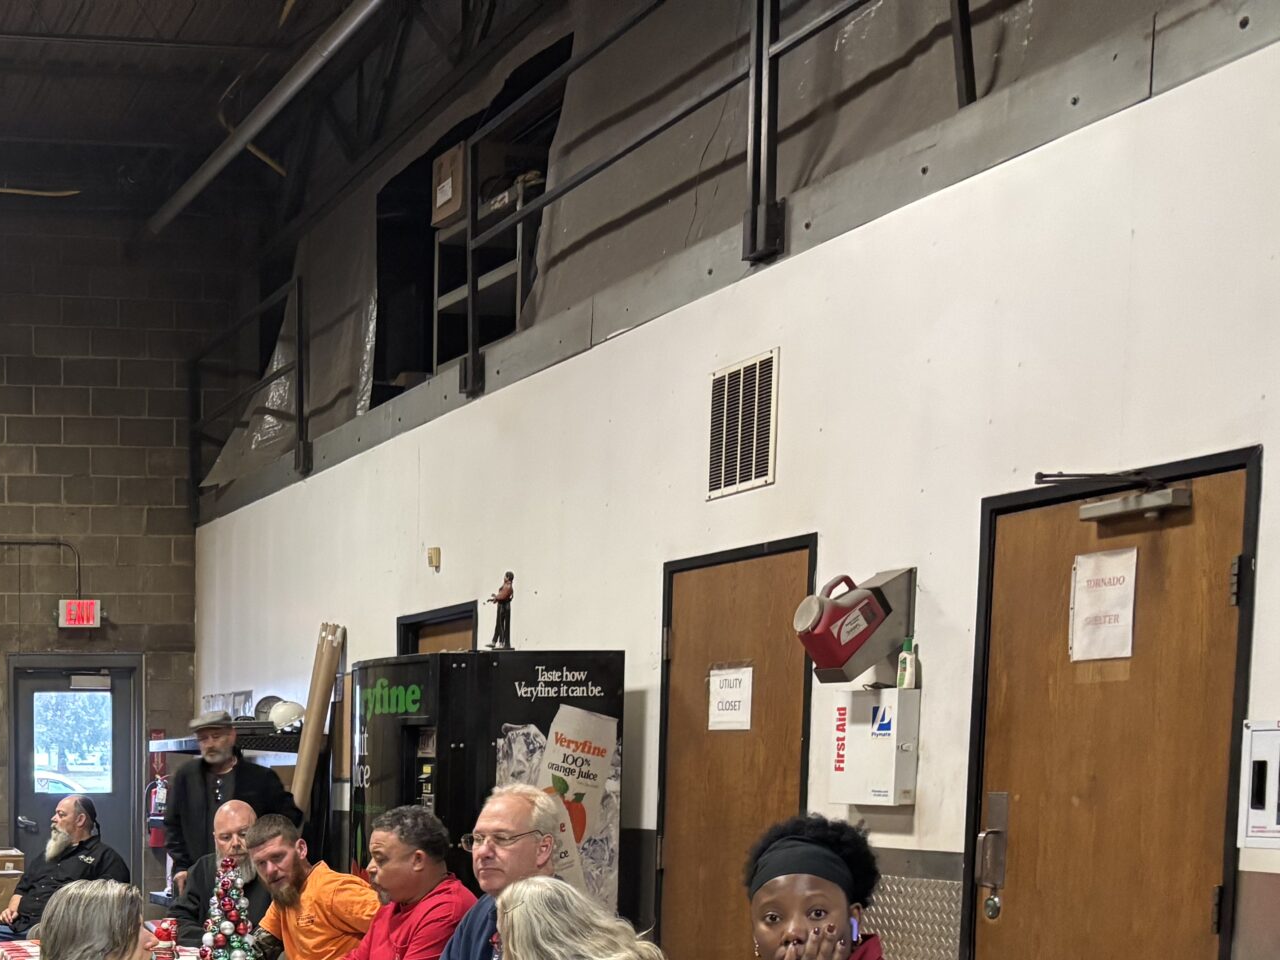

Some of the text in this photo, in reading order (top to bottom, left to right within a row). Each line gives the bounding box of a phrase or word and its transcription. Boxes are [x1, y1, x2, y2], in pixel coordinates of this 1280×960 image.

[1086, 575, 1125, 588] TORNADO
[66, 600, 95, 624] EXIT
[535, 666, 587, 682] Taste how
[719, 678, 742, 689] UTILITY
[361, 678, 420, 721] ryfine
[514, 681, 604, 702] Veryfine it can be.
[717, 700, 741, 711] CLOSET
[554, 731, 607, 758] Veryfine
[834, 707, 847, 772] First Aid
[561, 753, 591, 768] 100%
[548, 762, 598, 782] orange juice
